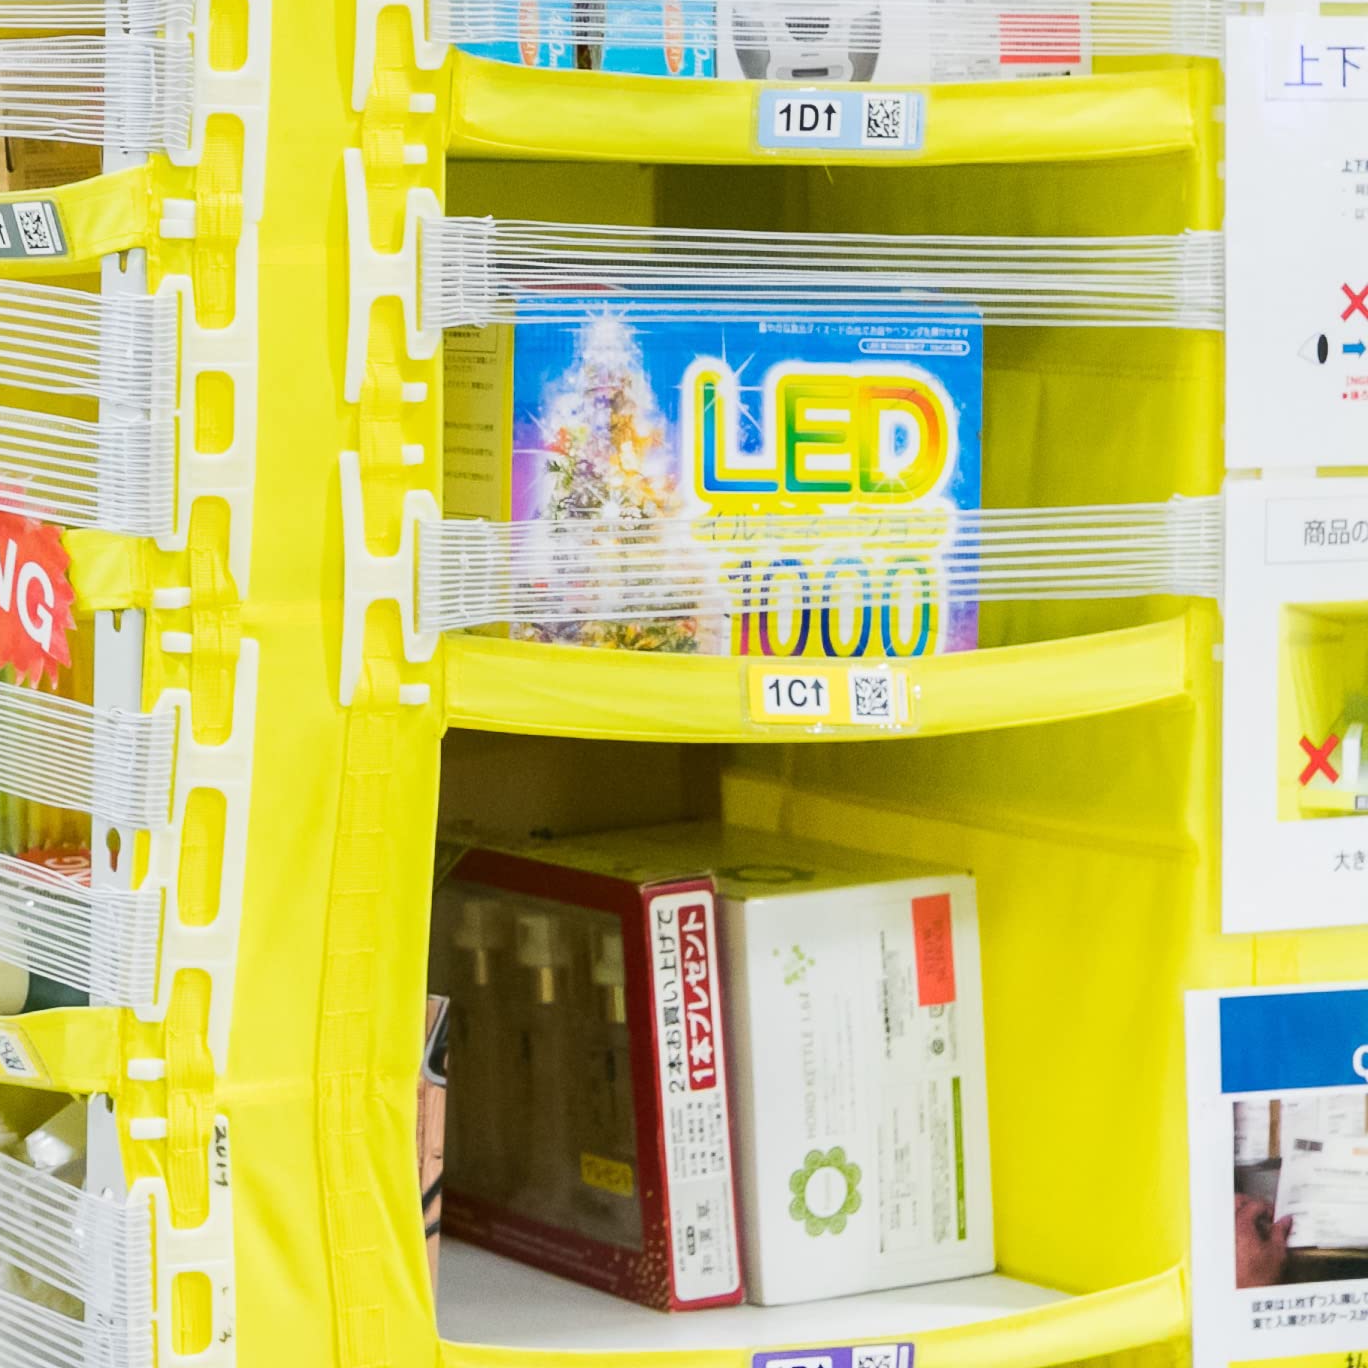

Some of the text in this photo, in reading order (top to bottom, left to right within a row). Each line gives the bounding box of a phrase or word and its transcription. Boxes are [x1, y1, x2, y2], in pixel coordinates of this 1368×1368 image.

[776, 103, 820, 132] 1D
[697, 373, 948, 502] LED
[769, 678, 808, 707] 1C
[682, 910, 715, 1082] 1本プレゼント
